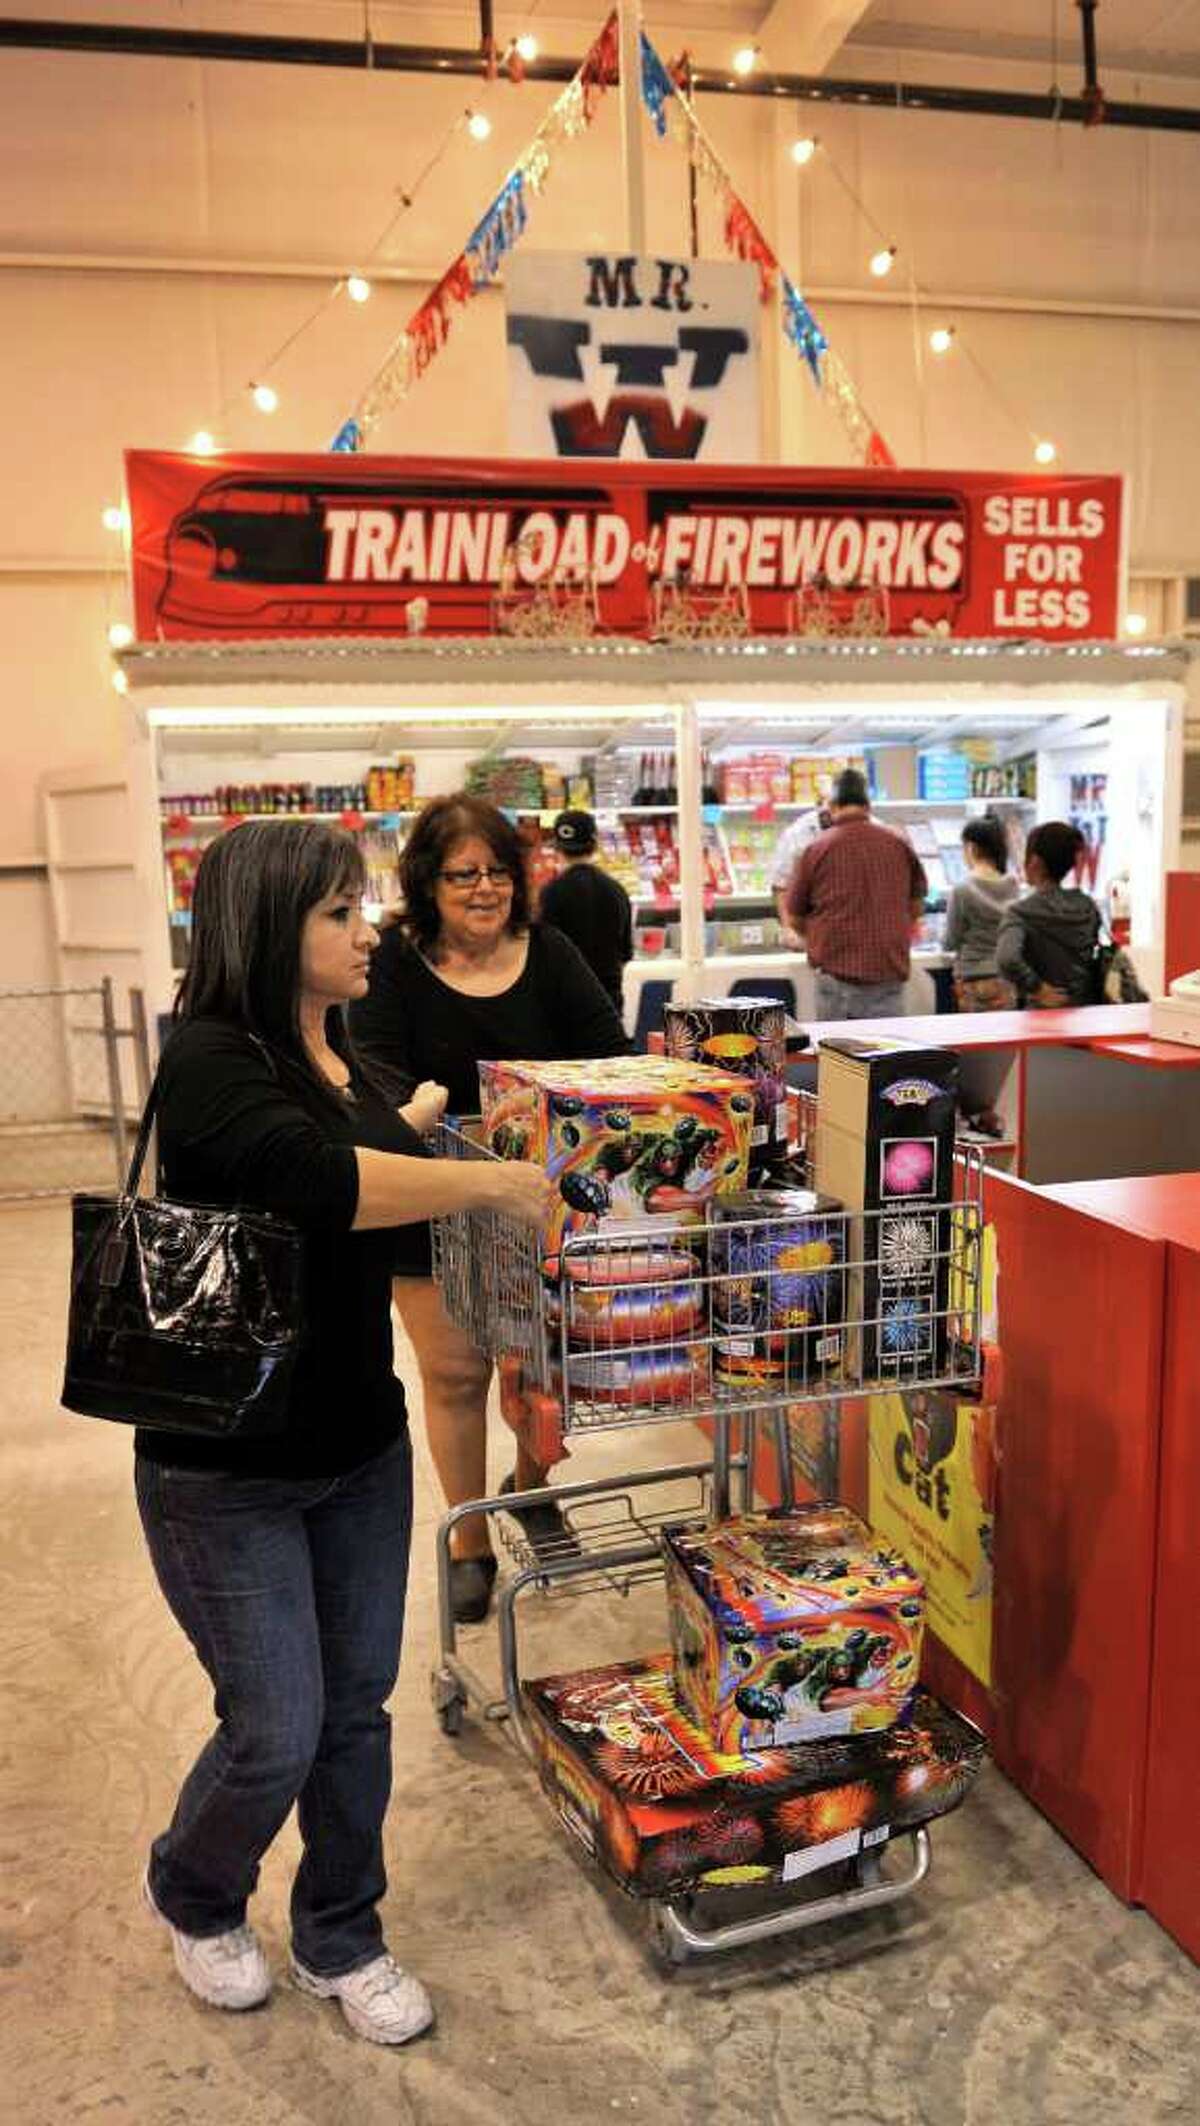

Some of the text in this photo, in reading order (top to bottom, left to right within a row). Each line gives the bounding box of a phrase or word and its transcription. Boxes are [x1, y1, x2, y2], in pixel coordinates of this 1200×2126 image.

[584, 257, 709, 312] MR.
[507, 314, 749, 460] W
[984, 496, 1105, 538] SELLS
[325, 510, 965, 589] TRAINLOAD of FIREWORKS
[1004, 544, 1082, 583] FOR
[994, 590, 1090, 628] LESS
[894, 1431, 951, 1522] Cat
